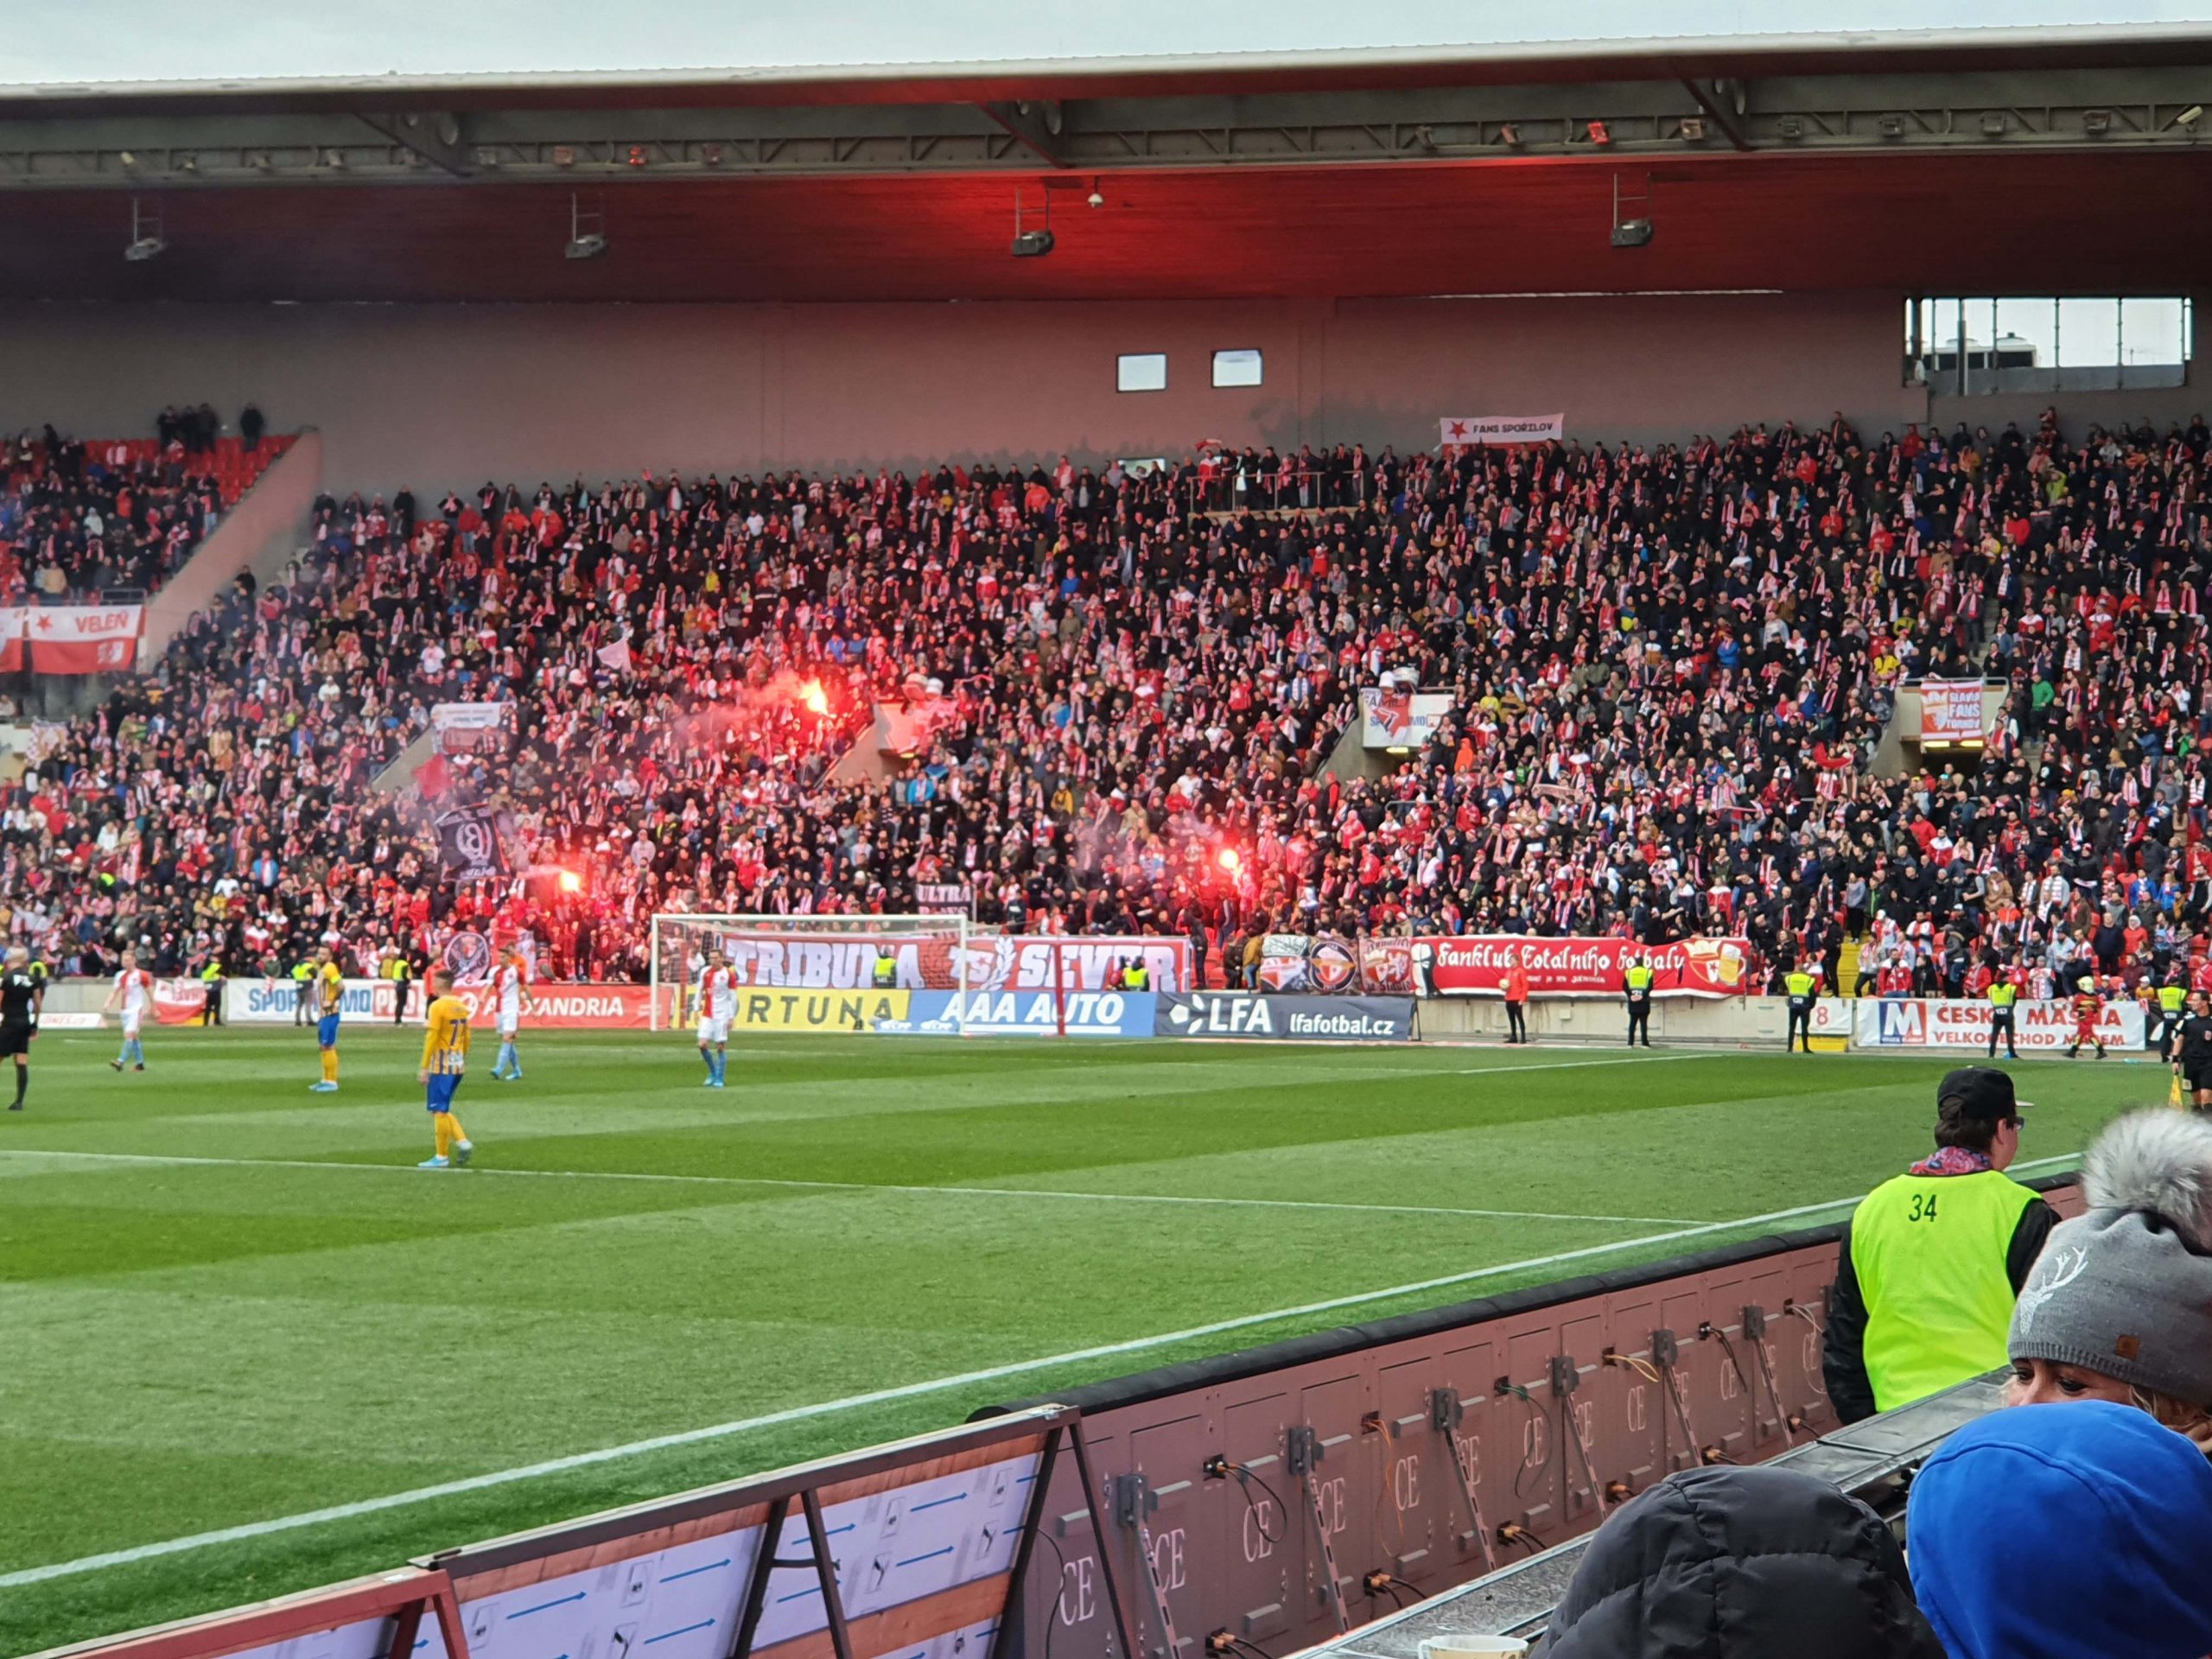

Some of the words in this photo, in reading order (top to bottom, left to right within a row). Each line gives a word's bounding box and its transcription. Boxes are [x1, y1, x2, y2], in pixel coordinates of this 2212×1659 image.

[1472, 423, 1499, 434] FANS
[1502, 421, 1554, 433] SPOŘILOV
[1948, 703, 1980, 718] FANS
[916, 884, 971, 903] ULTRA
[1437, 942, 1515, 968] Fanklub
[484, 996, 624, 1017] AXANDRIA
[686, 993, 893, 1026] FRTUNA
[940, 993, 1016, 1023] AAA
[1025, 993, 1124, 1024] AUTO
[1209, 998, 1273, 1032] LFA
[1290, 1013, 1395, 1035] lfafotbal.cz
[1816, 1006, 1829, 1026] 8
[1908, 1193, 1938, 1223] 34
[1627, 1385, 1647, 1432] CE
[1523, 1417, 1545, 1468] CE
[1395, 1455, 1420, 1512] CE
[1320, 1478, 1346, 1536] CE
[1243, 1500, 1274, 1563] CE
[1154, 1528, 1186, 1593] CE
[1059, 1556, 1096, 1627] CE
